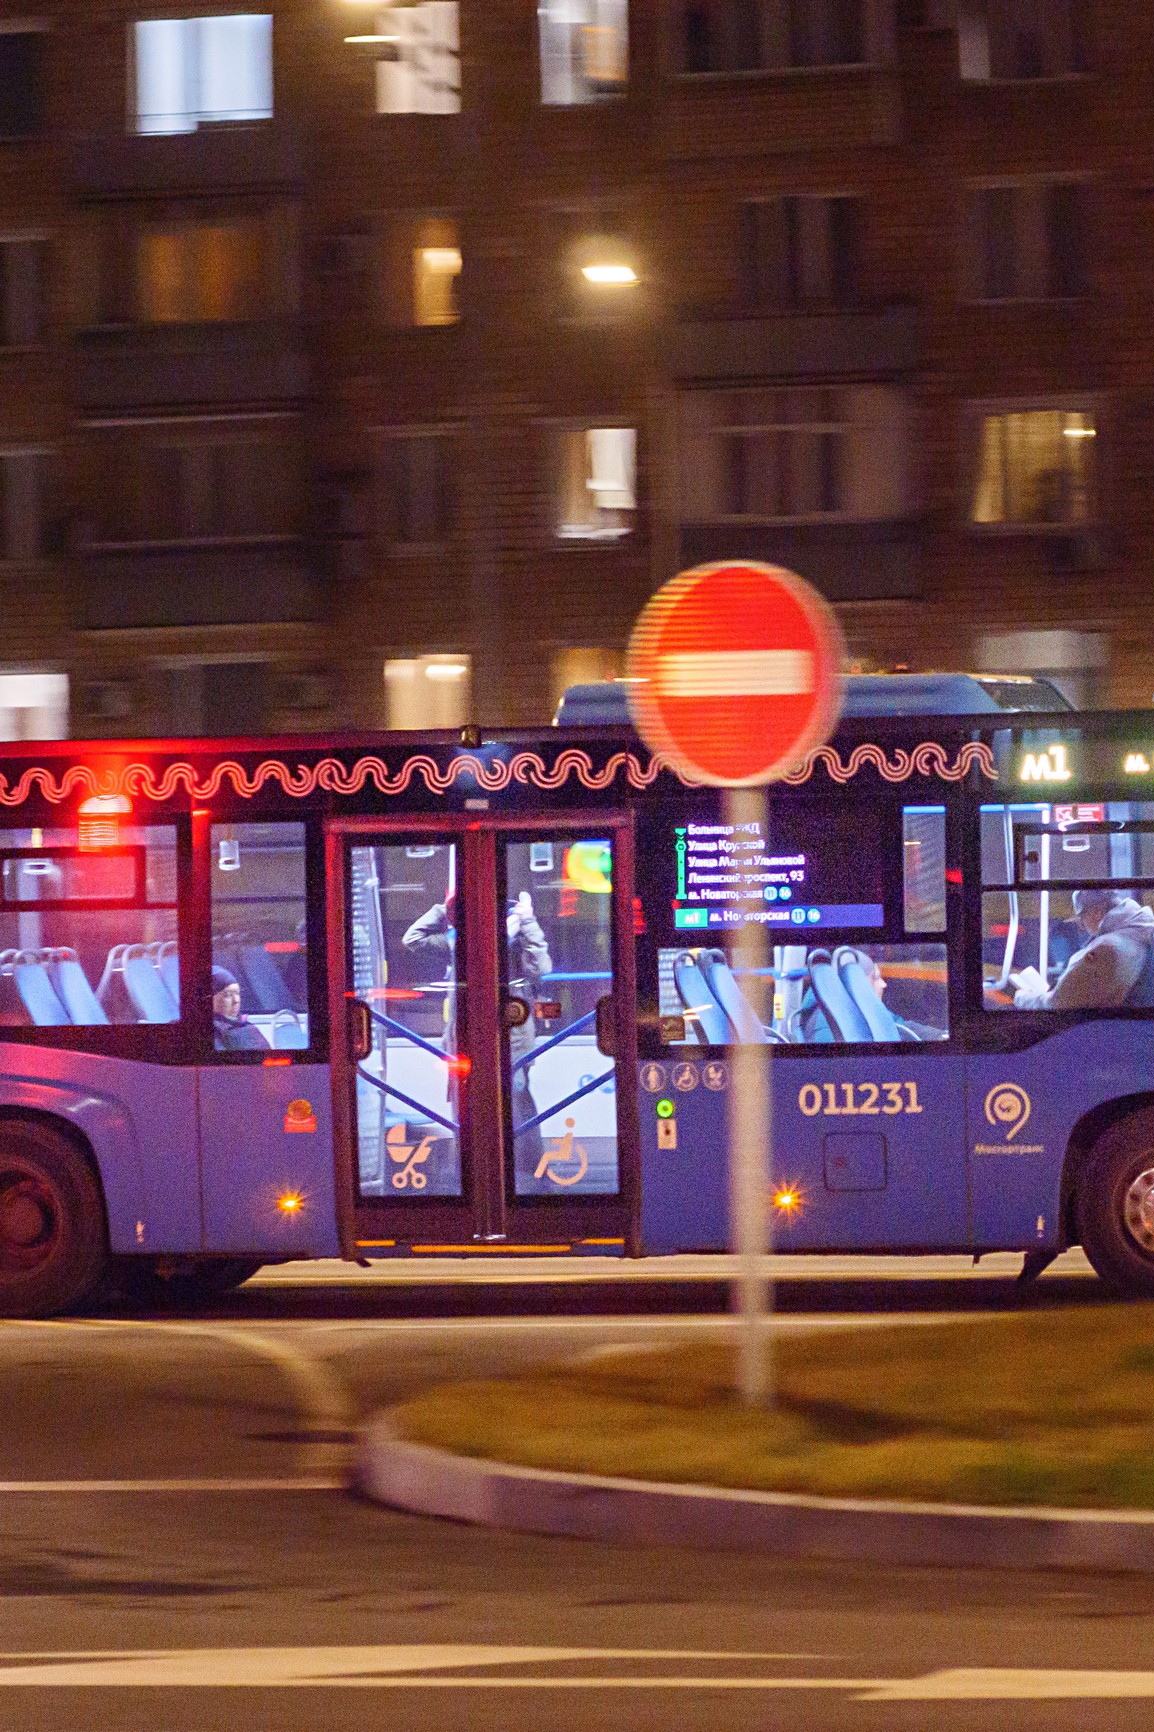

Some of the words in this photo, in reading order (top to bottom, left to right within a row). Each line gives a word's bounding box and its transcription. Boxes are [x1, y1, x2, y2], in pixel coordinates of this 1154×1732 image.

[687, 823, 734, 835] Больница
[687, 840, 718, 851] Улица
[718, 839, 765, 853] Круской
[687, 856, 718, 867] Улица
[719, 856, 753, 868] Мари
[753, 854, 805, 866] Ульяновой
[789, 870, 804, 882] 93
[710, 912, 722, 921] м.
[798, 1081, 923, 1116] 011231
